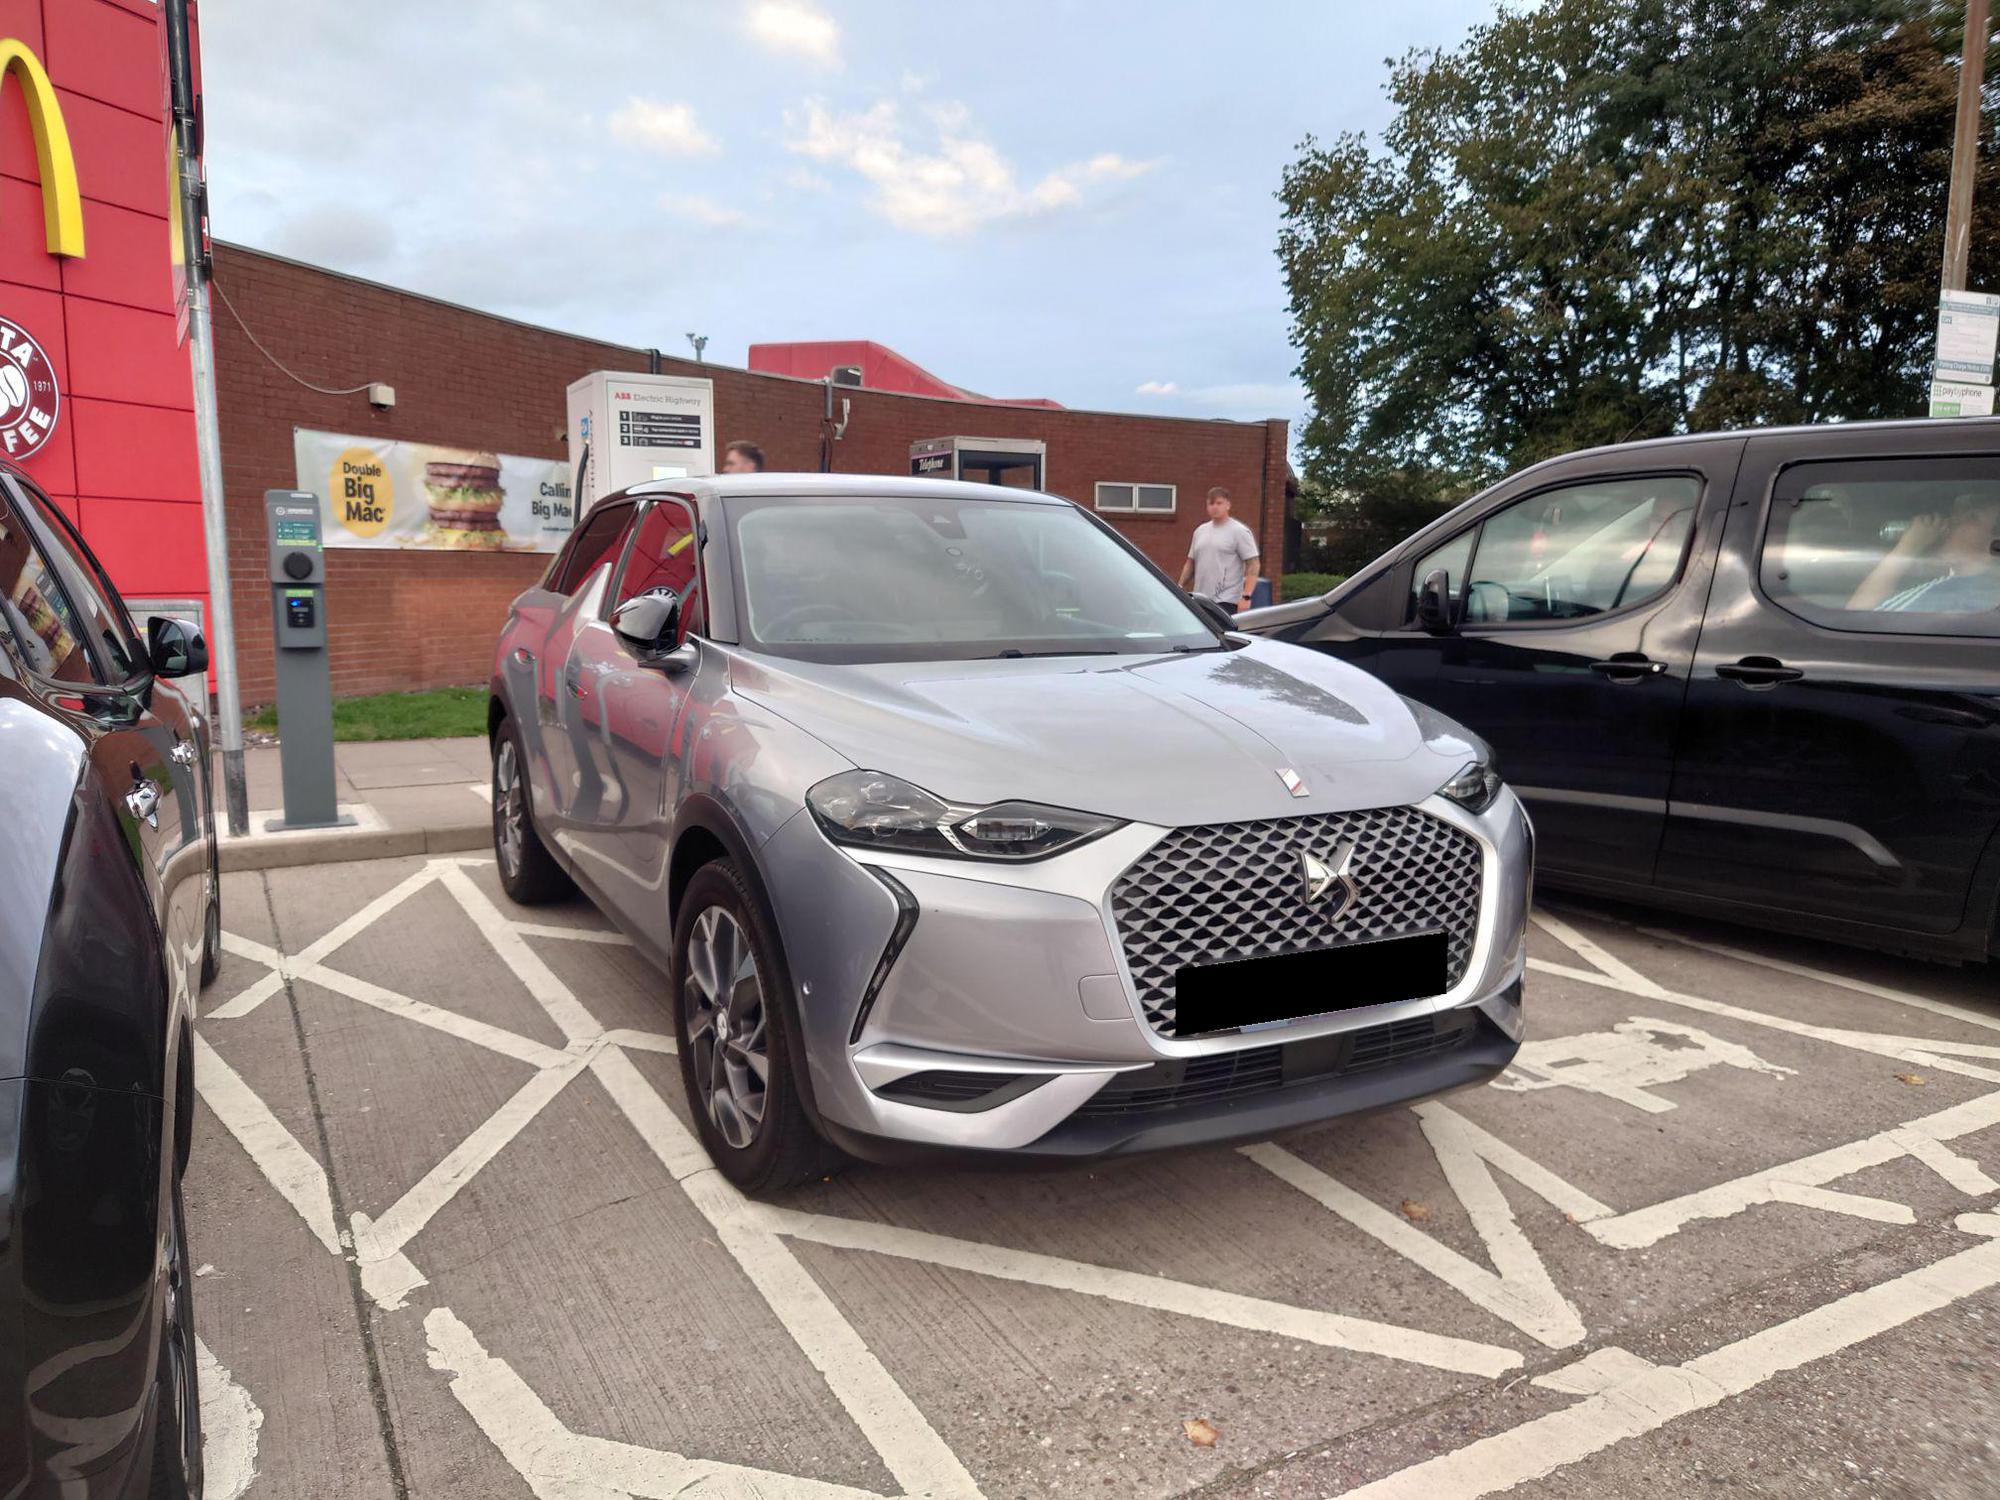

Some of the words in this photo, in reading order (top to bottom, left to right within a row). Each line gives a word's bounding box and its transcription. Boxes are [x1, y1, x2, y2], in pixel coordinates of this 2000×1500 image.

[0, 326, 33, 369] TA
[33, 380, 51, 392] 1971
[2, 406, 51, 453] FEE
[343, 462, 382, 477] Double
[919, 457, 944, 472] Telephone
[344, 476, 375, 505] Big
[540, 482, 571, 498] Callin
[346, 501, 384, 523] Mac
[532, 501, 551, 520] Big
